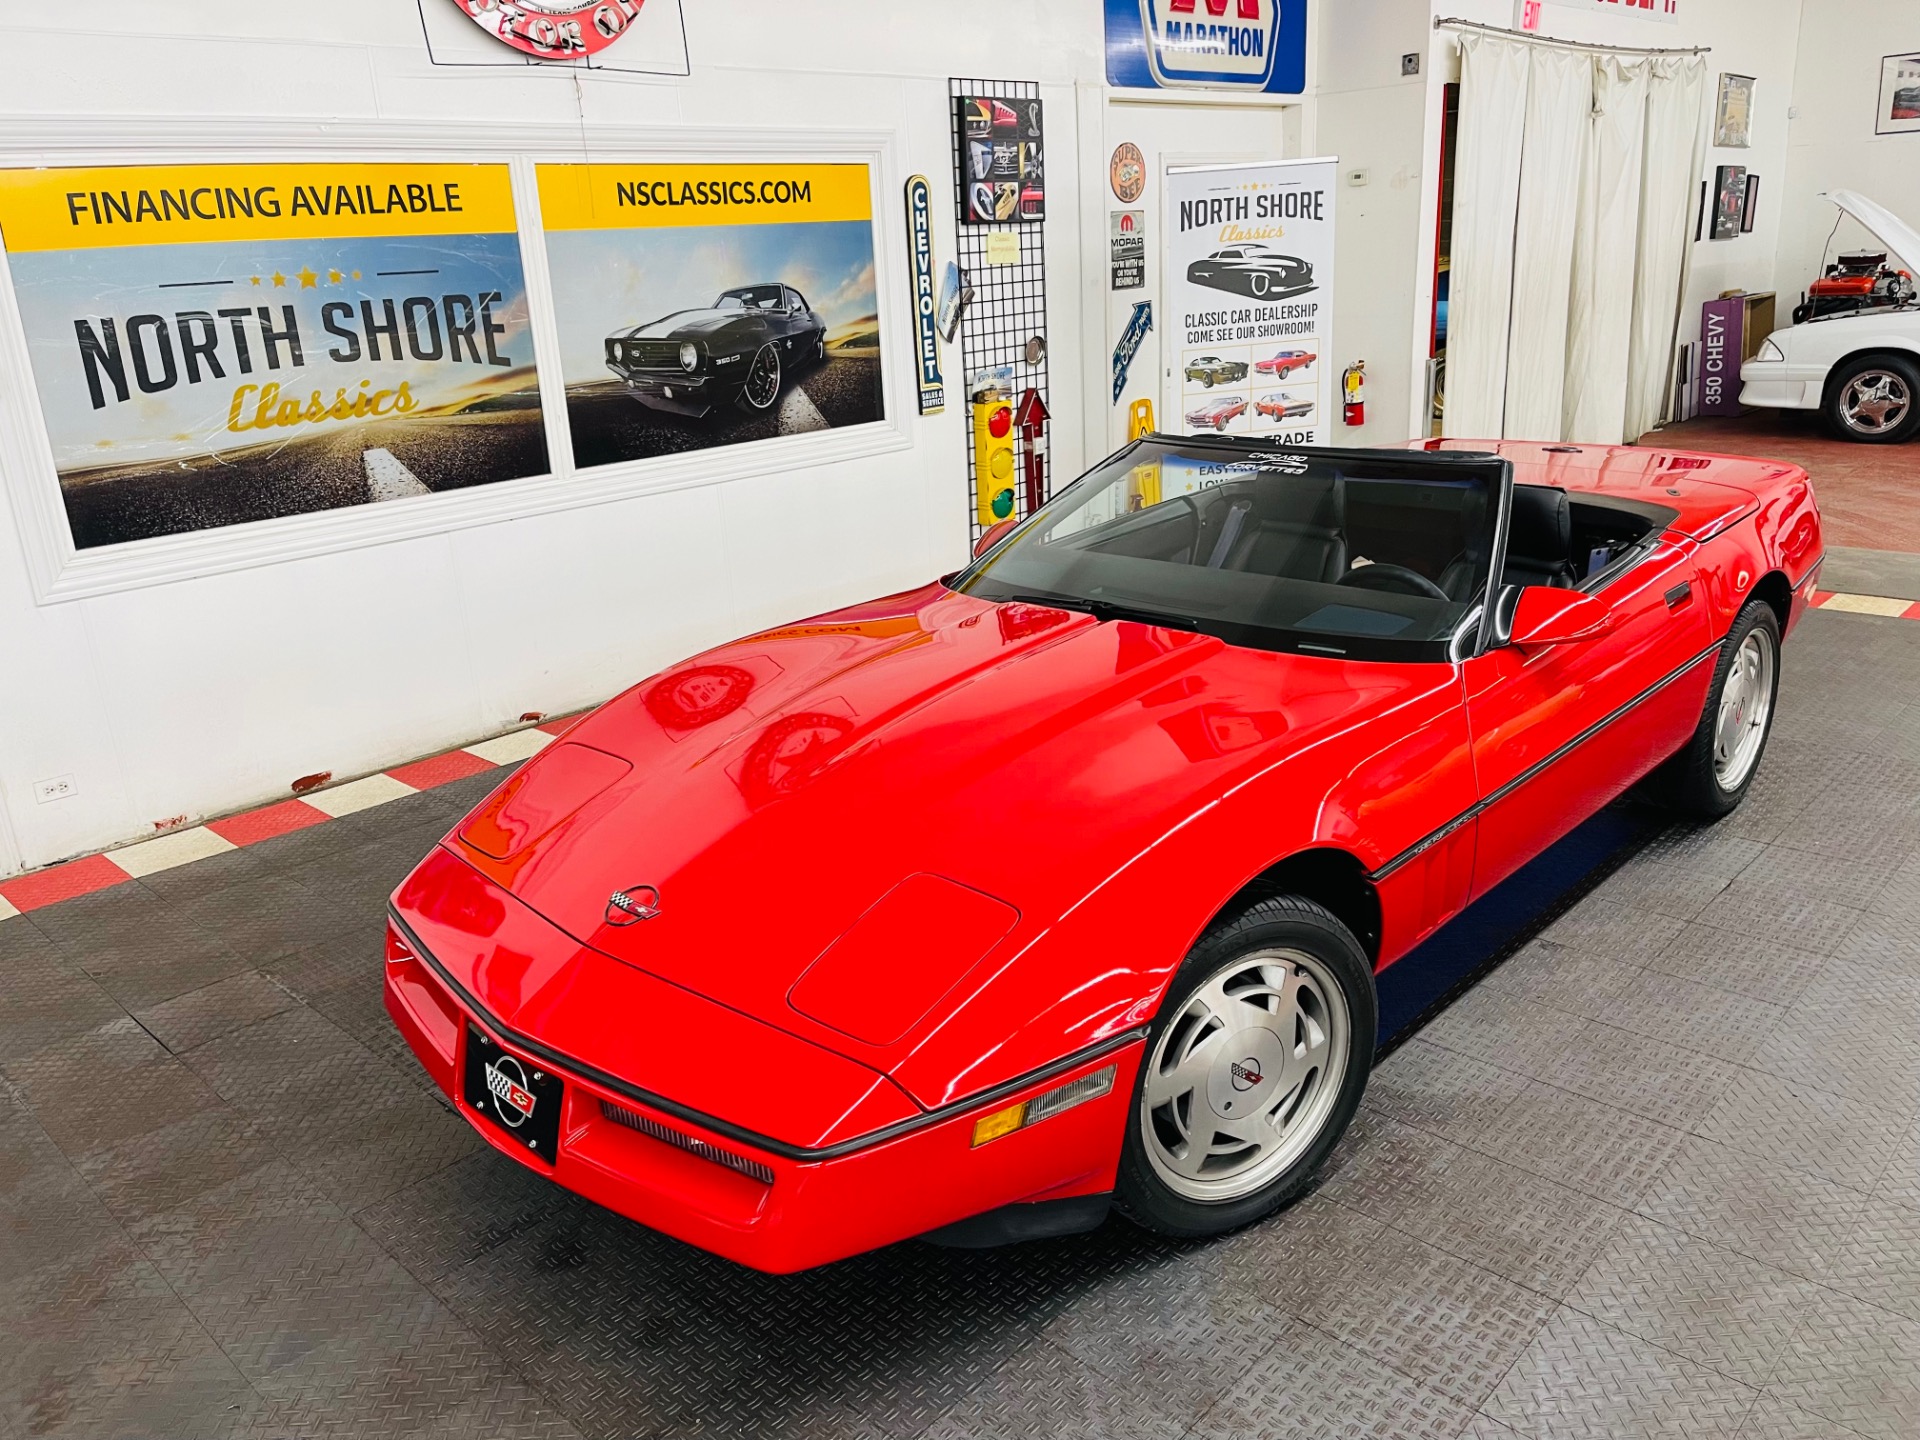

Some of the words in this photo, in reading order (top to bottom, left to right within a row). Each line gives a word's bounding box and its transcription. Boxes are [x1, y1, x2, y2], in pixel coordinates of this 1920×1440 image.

[1523, 0, 1541, 30] EXIT
[1166, 20, 1264, 57] MARATHON
[1113, 146, 1141, 177] SUPER
[616, 181, 812, 207] NSCLASSICS.COM
[1119, 178, 1140, 199] BEE
[66, 186, 281, 226] FINANCING
[291, 183, 463, 217] AVAILABLE
[1180, 196, 1249, 232] NORTH
[1256, 190, 1324, 221] SHORE
[1111, 237, 1144, 247] MOPAR
[1219, 224, 1285, 243] Classics
[914, 188, 936, 379] CHEVROLET
[1185, 310, 1228, 328] CLASSIC
[1230, 309, 1252, 324] CAR
[1255, 303, 1318, 322] DEALERSHIP
[1120, 322, 1142, 365] Ford
[1187, 330, 1214, 344] COME
[1217, 328, 1234, 341] SEE
[1236, 326, 1255, 339] OUR
[1258, 321, 1315, 338] SHOWROOM!
[1706, 313, 1725, 372] CHEVY
[73, 304, 305, 411] NORTH
[321, 291, 512, 368] SHORE
[922, 390, 938, 400] SALES
[922, 397, 944, 408] SERVICE
[1705, 377, 1722, 405] 350
[227, 378, 420, 434] Classics
[1248, 452, 1308, 462] CHICAGO
